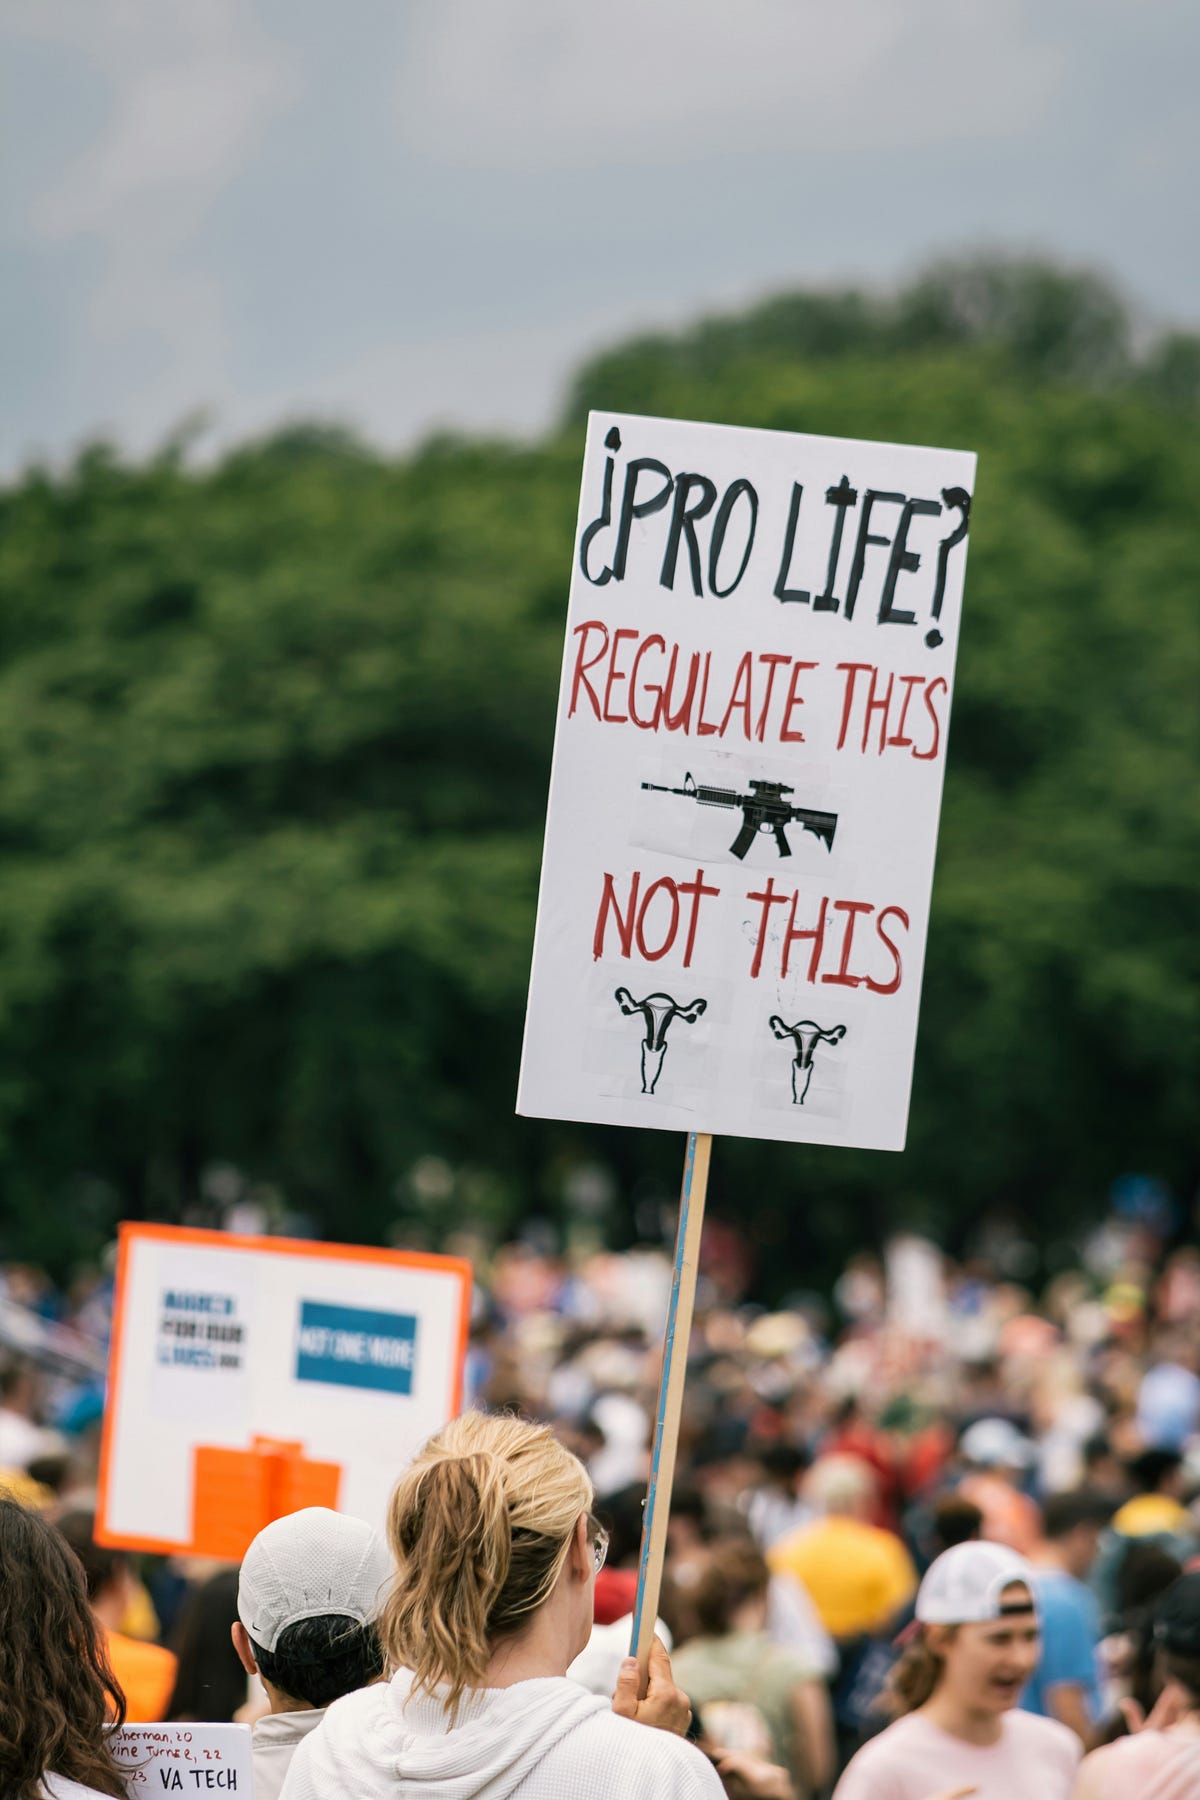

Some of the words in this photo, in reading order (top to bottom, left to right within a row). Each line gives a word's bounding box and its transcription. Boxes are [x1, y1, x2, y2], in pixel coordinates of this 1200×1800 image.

[580, 426, 760, 599] ¿PRO
[773, 474, 972, 649] LIFE?
[568, 620, 820, 743] REGULATE
[836, 662, 948, 760] THIS
[592, 868, 721, 969] NOT
[746, 877, 910, 995] THIS
[176, 1731, 193, 1743] 20
[203, 1749, 223, 1760] 22
[160, 1767, 184, 1791] VA
[189, 1767, 238, 1791] TECH
